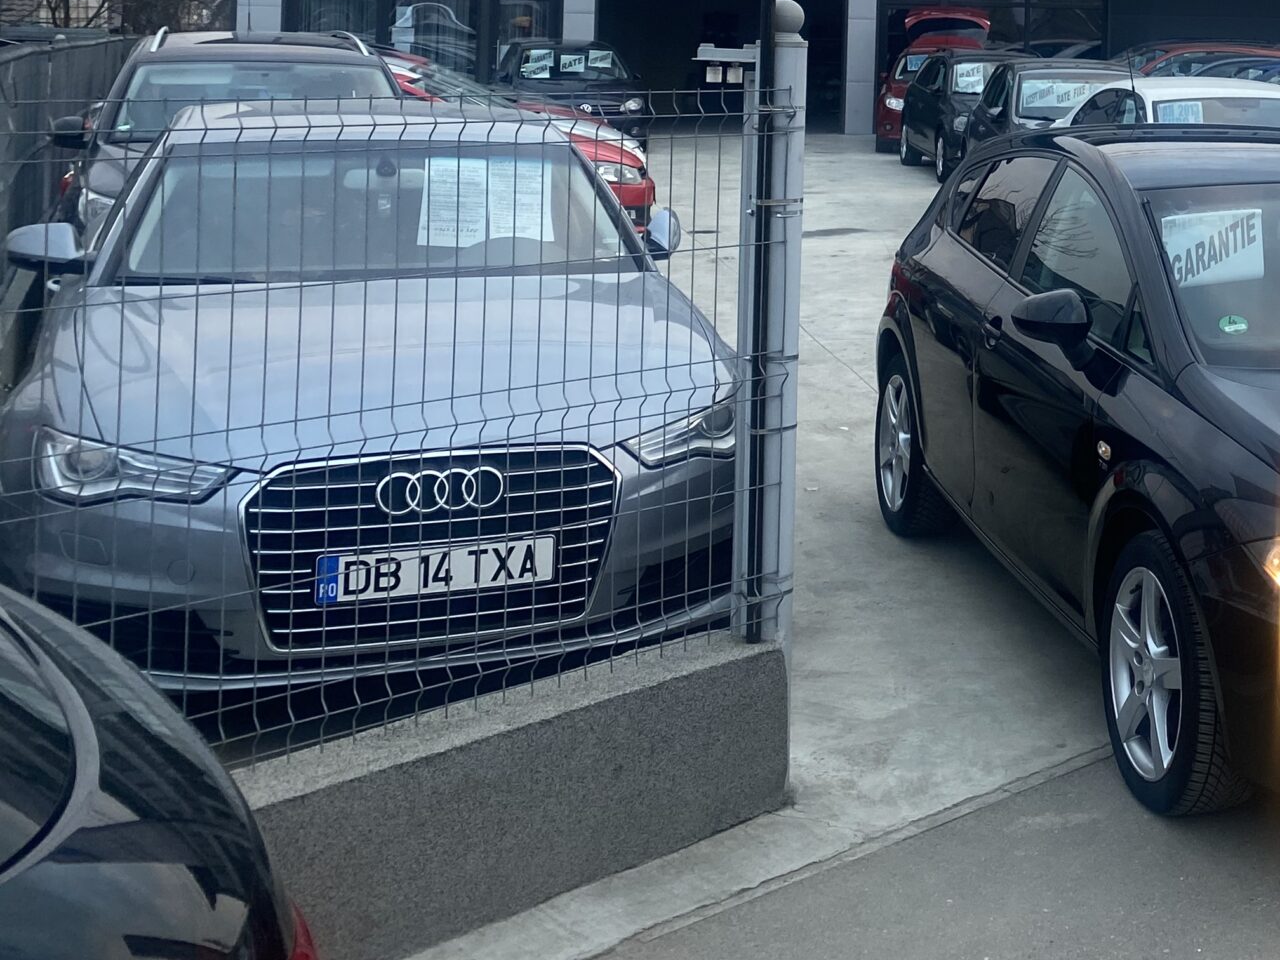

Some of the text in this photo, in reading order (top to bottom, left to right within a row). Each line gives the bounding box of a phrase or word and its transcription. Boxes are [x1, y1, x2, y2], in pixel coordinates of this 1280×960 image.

[561, 57, 583, 71] RATE
[1057, 91, 1071, 105] RATE
[1171, 212, 1257, 286] GARANTIE
[343, 556, 402, 596] DB
[419, 551, 453, 589] 14
[467, 544, 538, 583] TXA
